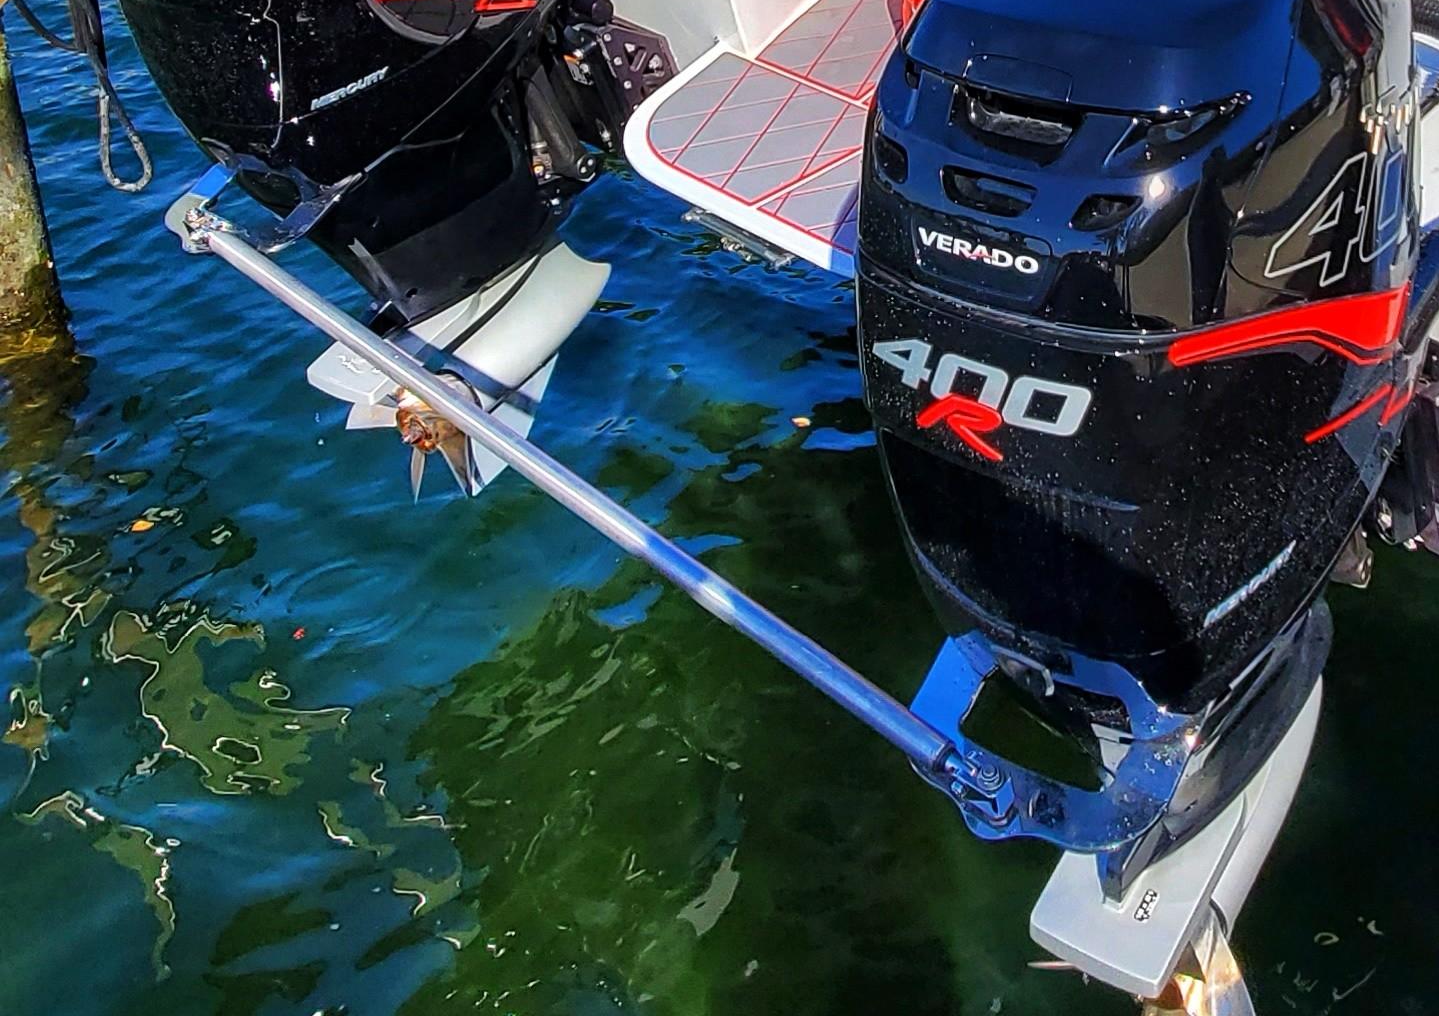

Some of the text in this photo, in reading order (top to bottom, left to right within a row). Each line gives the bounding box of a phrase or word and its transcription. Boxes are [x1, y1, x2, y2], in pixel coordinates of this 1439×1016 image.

[918, 227, 1039, 274] VERADO
[872, 339, 1091, 436] 400
[916, 393, 1003, 461] R
